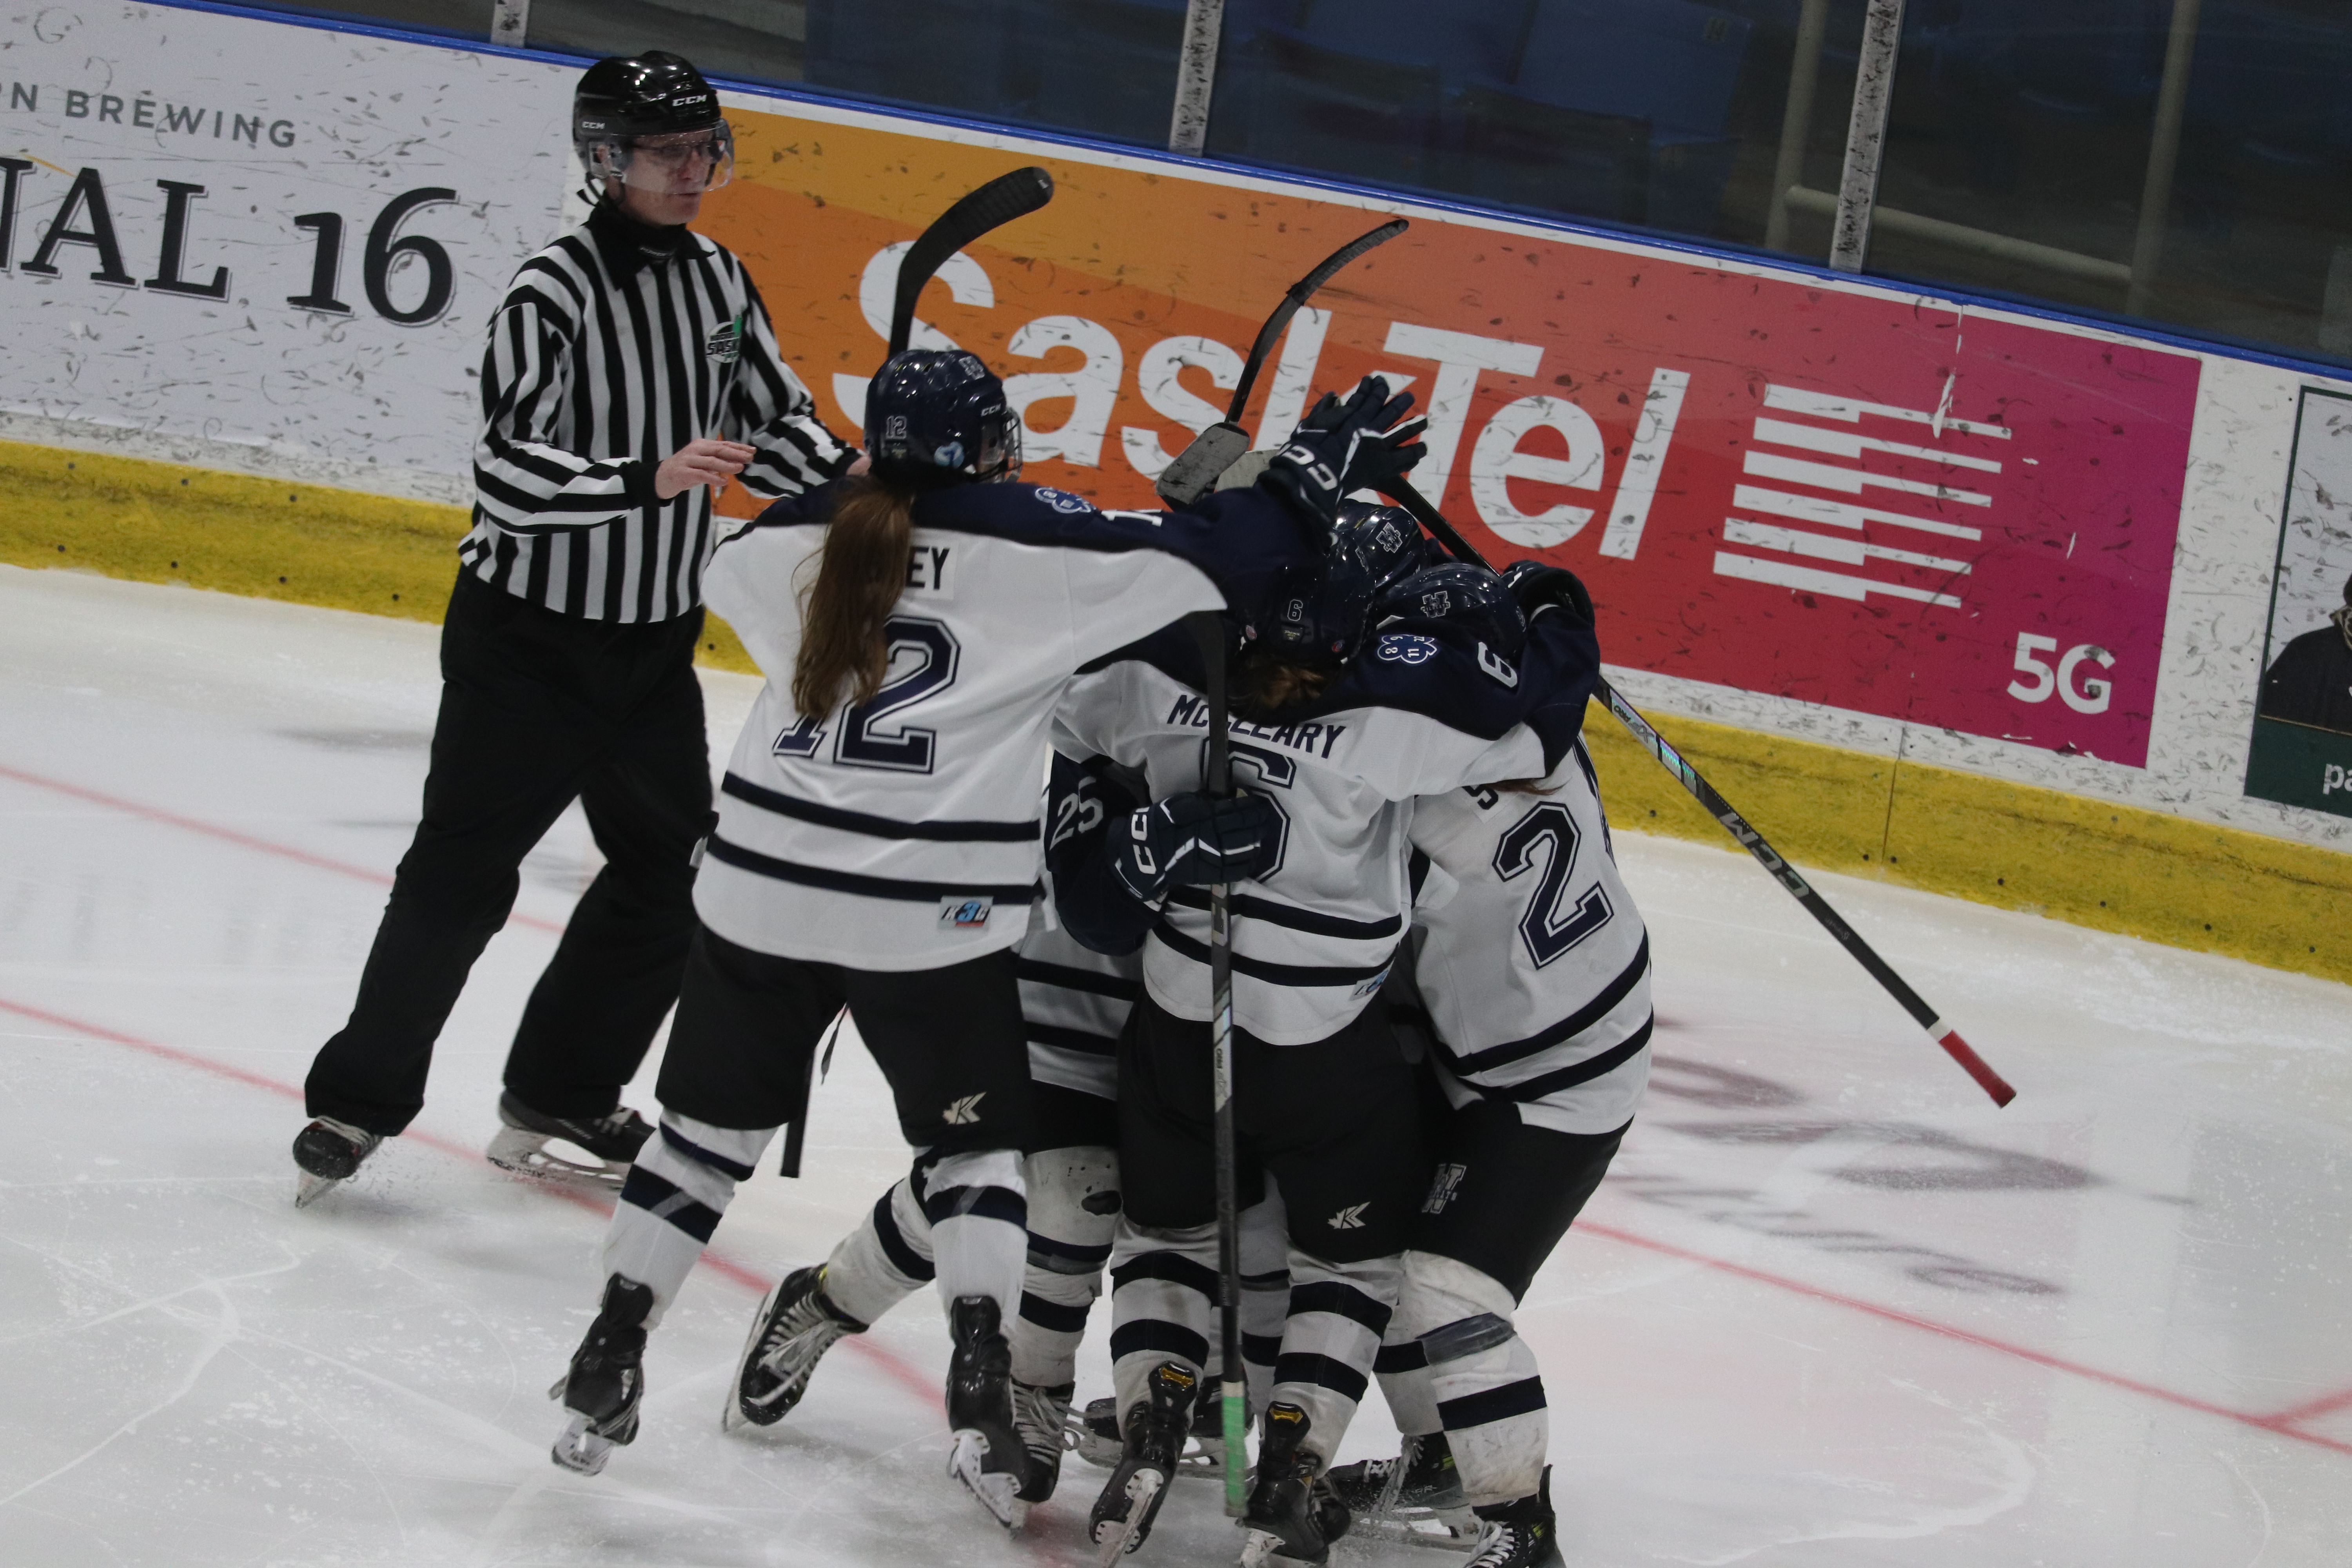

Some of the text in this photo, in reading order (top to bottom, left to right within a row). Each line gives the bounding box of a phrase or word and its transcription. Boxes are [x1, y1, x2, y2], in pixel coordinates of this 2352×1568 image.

[0, 82, 296, 148] N BREWING
[582, 121, 605, 130] CCM
[672, 94, 707, 107] CCM
[287, 187, 459, 328] 16
[886, 415, 907, 439] 12
[1278, 443, 1338, 491] CC
[906, 545, 951, 591] EY
[1287, 599, 1303, 622] 6
[2006, 631, 2116, 715] 5G
[1167, 694, 1346, 759] MCLEARY
[1049, 776, 1103, 851] 25
[1131, 806, 1156, 875] CC
[1491, 800, 1615, 971] 2
[1719, 812, 1810, 898] CCM
